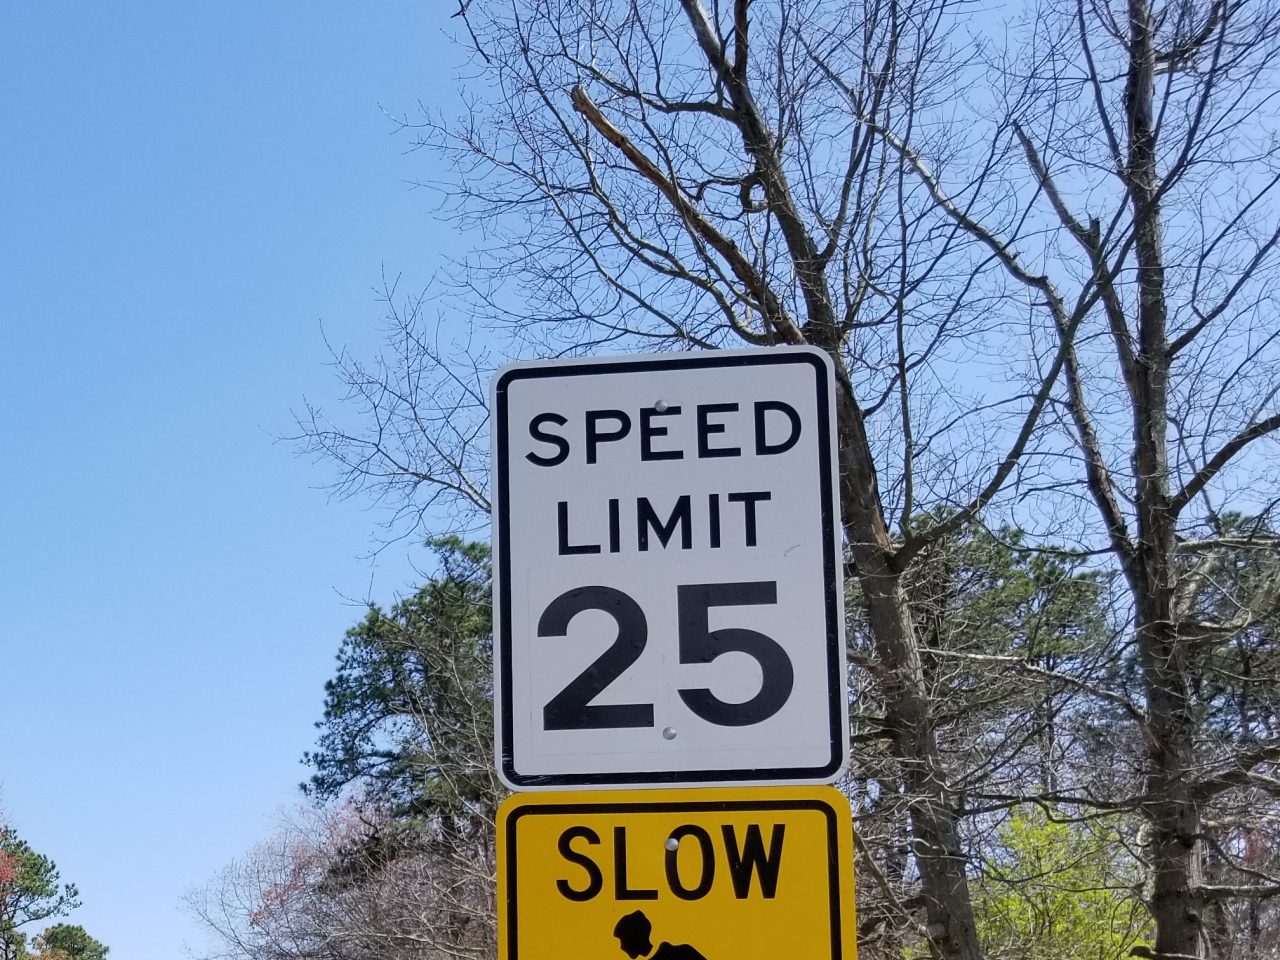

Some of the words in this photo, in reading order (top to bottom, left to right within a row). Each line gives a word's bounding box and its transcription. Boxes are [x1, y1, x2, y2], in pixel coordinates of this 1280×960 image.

[525, 401, 802, 467] SPEED
[558, 491, 772, 555] LIMIT
[537, 581, 794, 731] 25
[556, 824, 785, 902] SLOW
